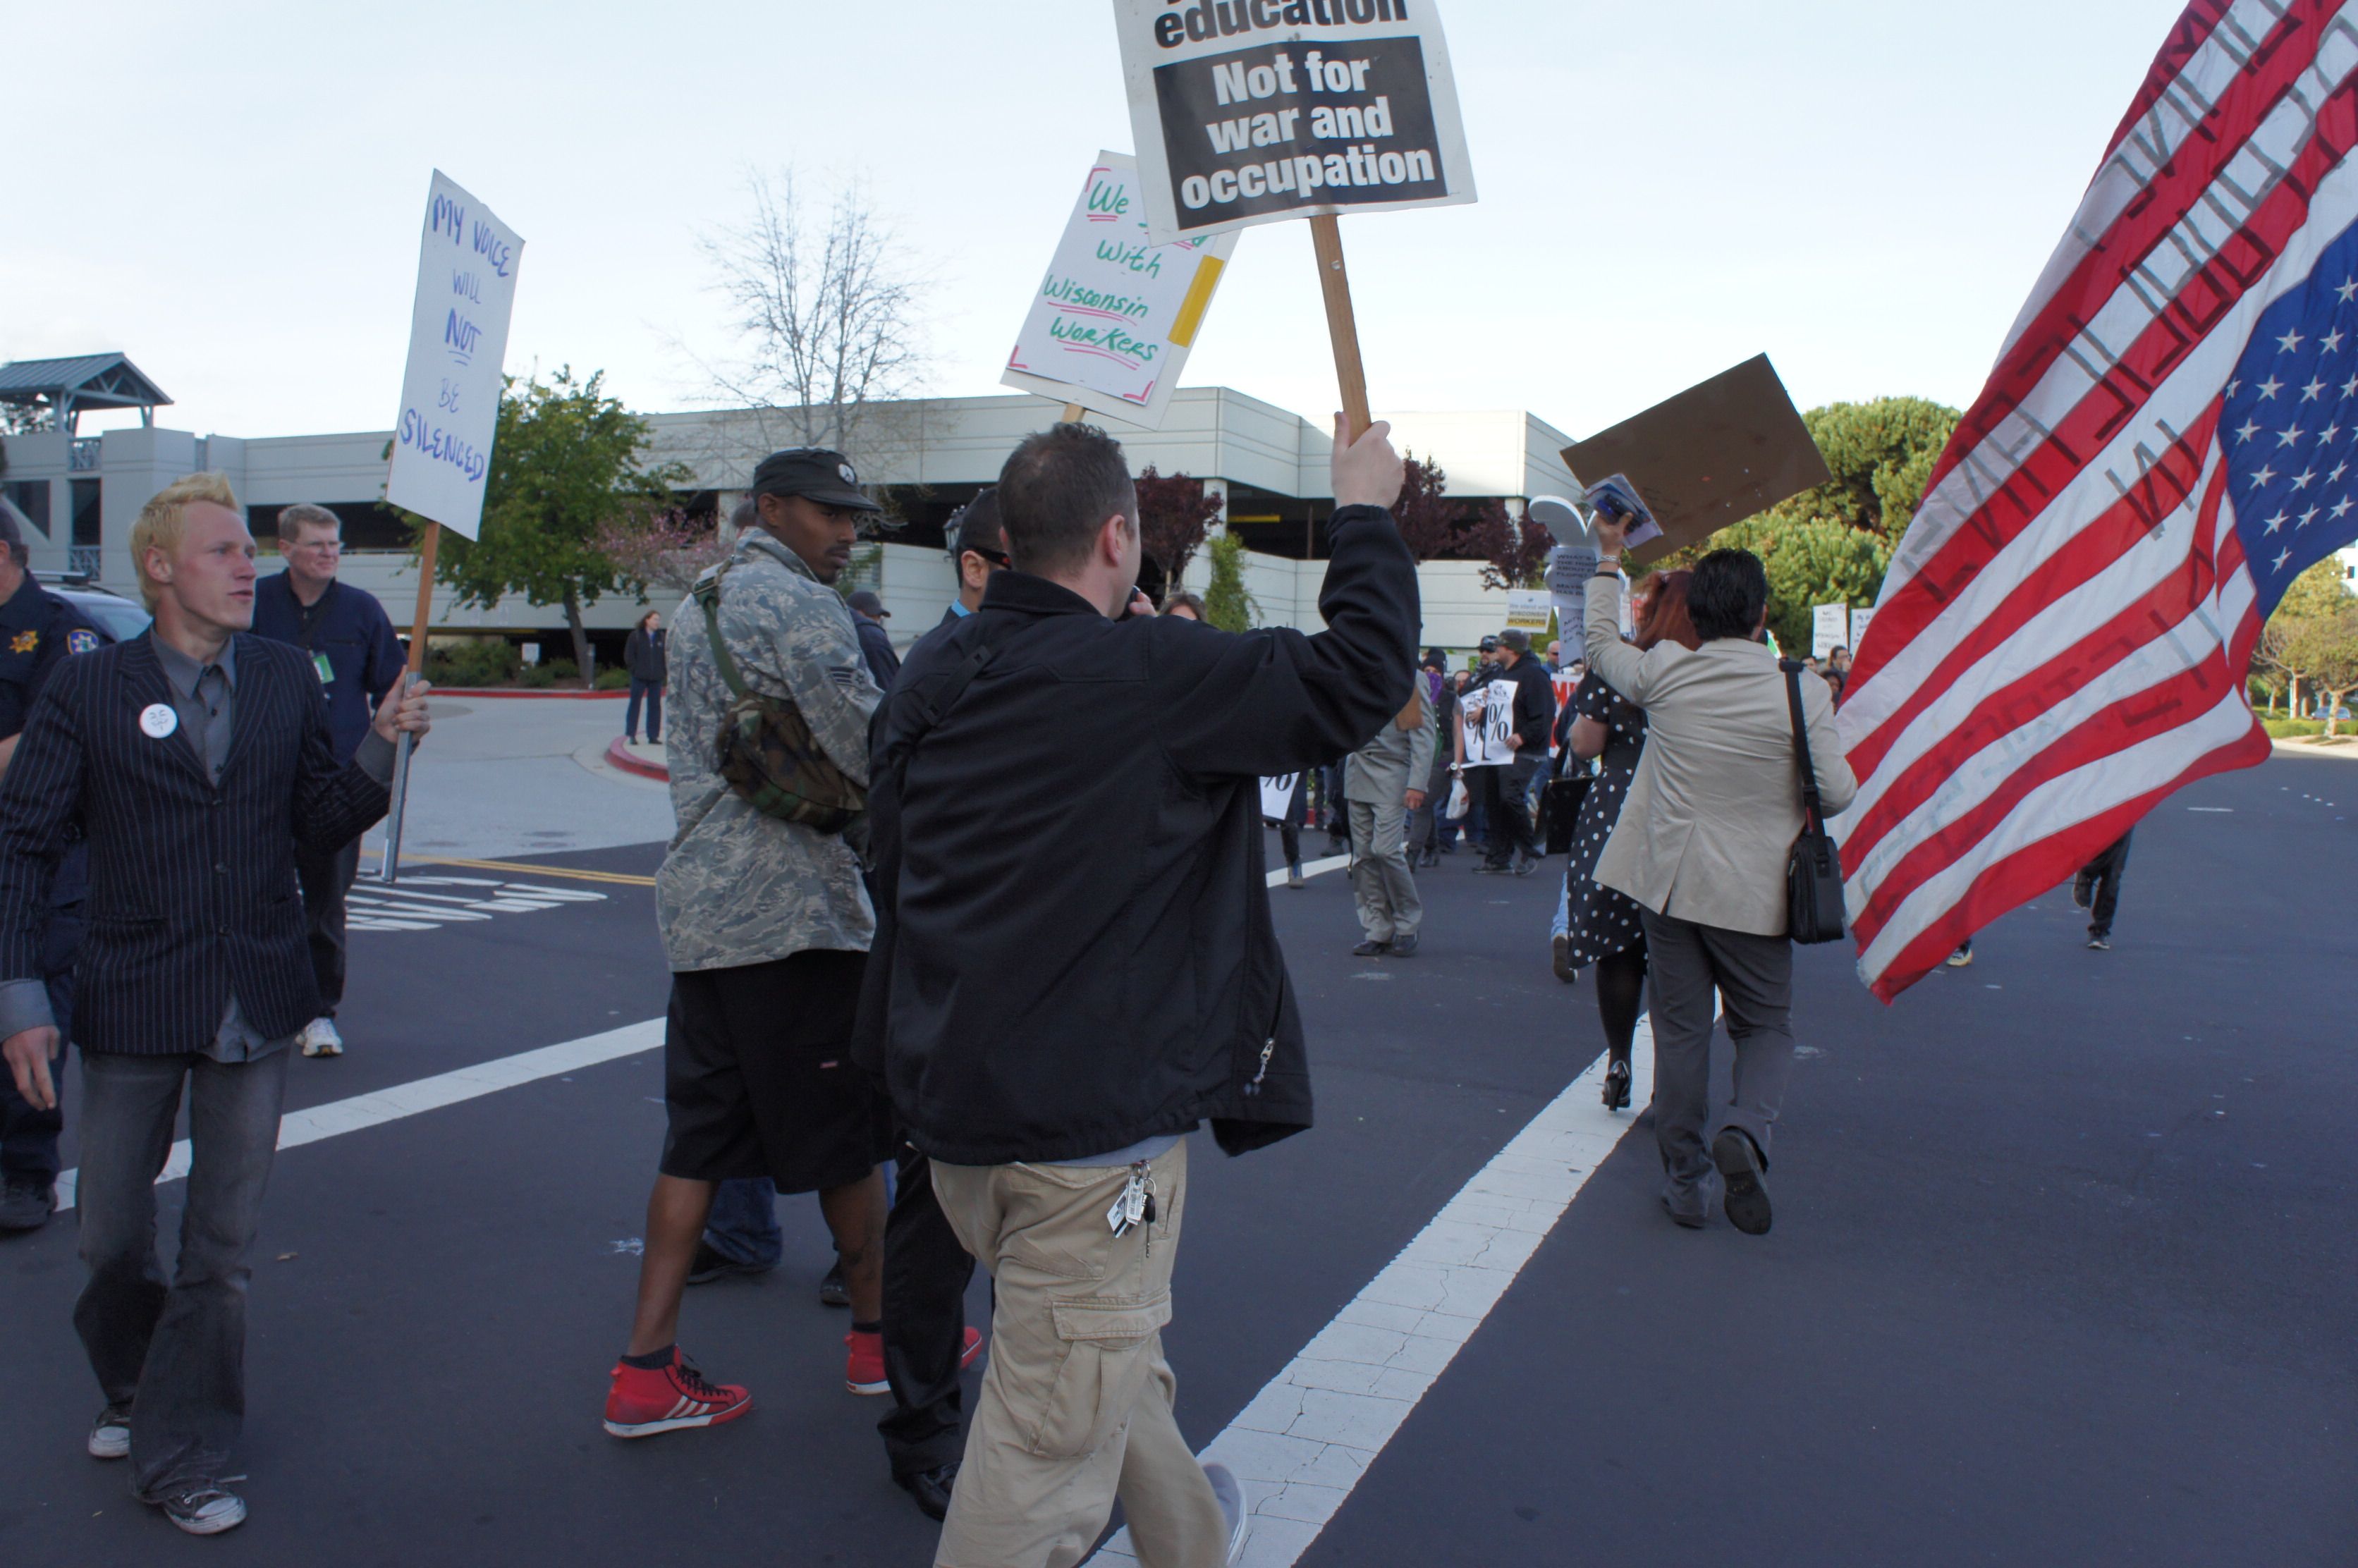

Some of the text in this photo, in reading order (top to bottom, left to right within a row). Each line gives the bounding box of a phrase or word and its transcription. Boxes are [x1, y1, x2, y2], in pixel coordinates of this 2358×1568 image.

[1211, 51, 1369, 106] Not for
[1206, 96, 1393, 154] war and
[1087, 180, 1128, 214] We
[1180, 145, 1436, 209] occupation
[433, 193, 510, 277] MY VOICE
[453, 269, 481, 304] WILL
[1043, 274, 1149, 318] Wisconsin
[444, 308, 482, 353] NOT
[439, 377, 459, 412] BE
[400, 408, 484, 482] SILENCED
